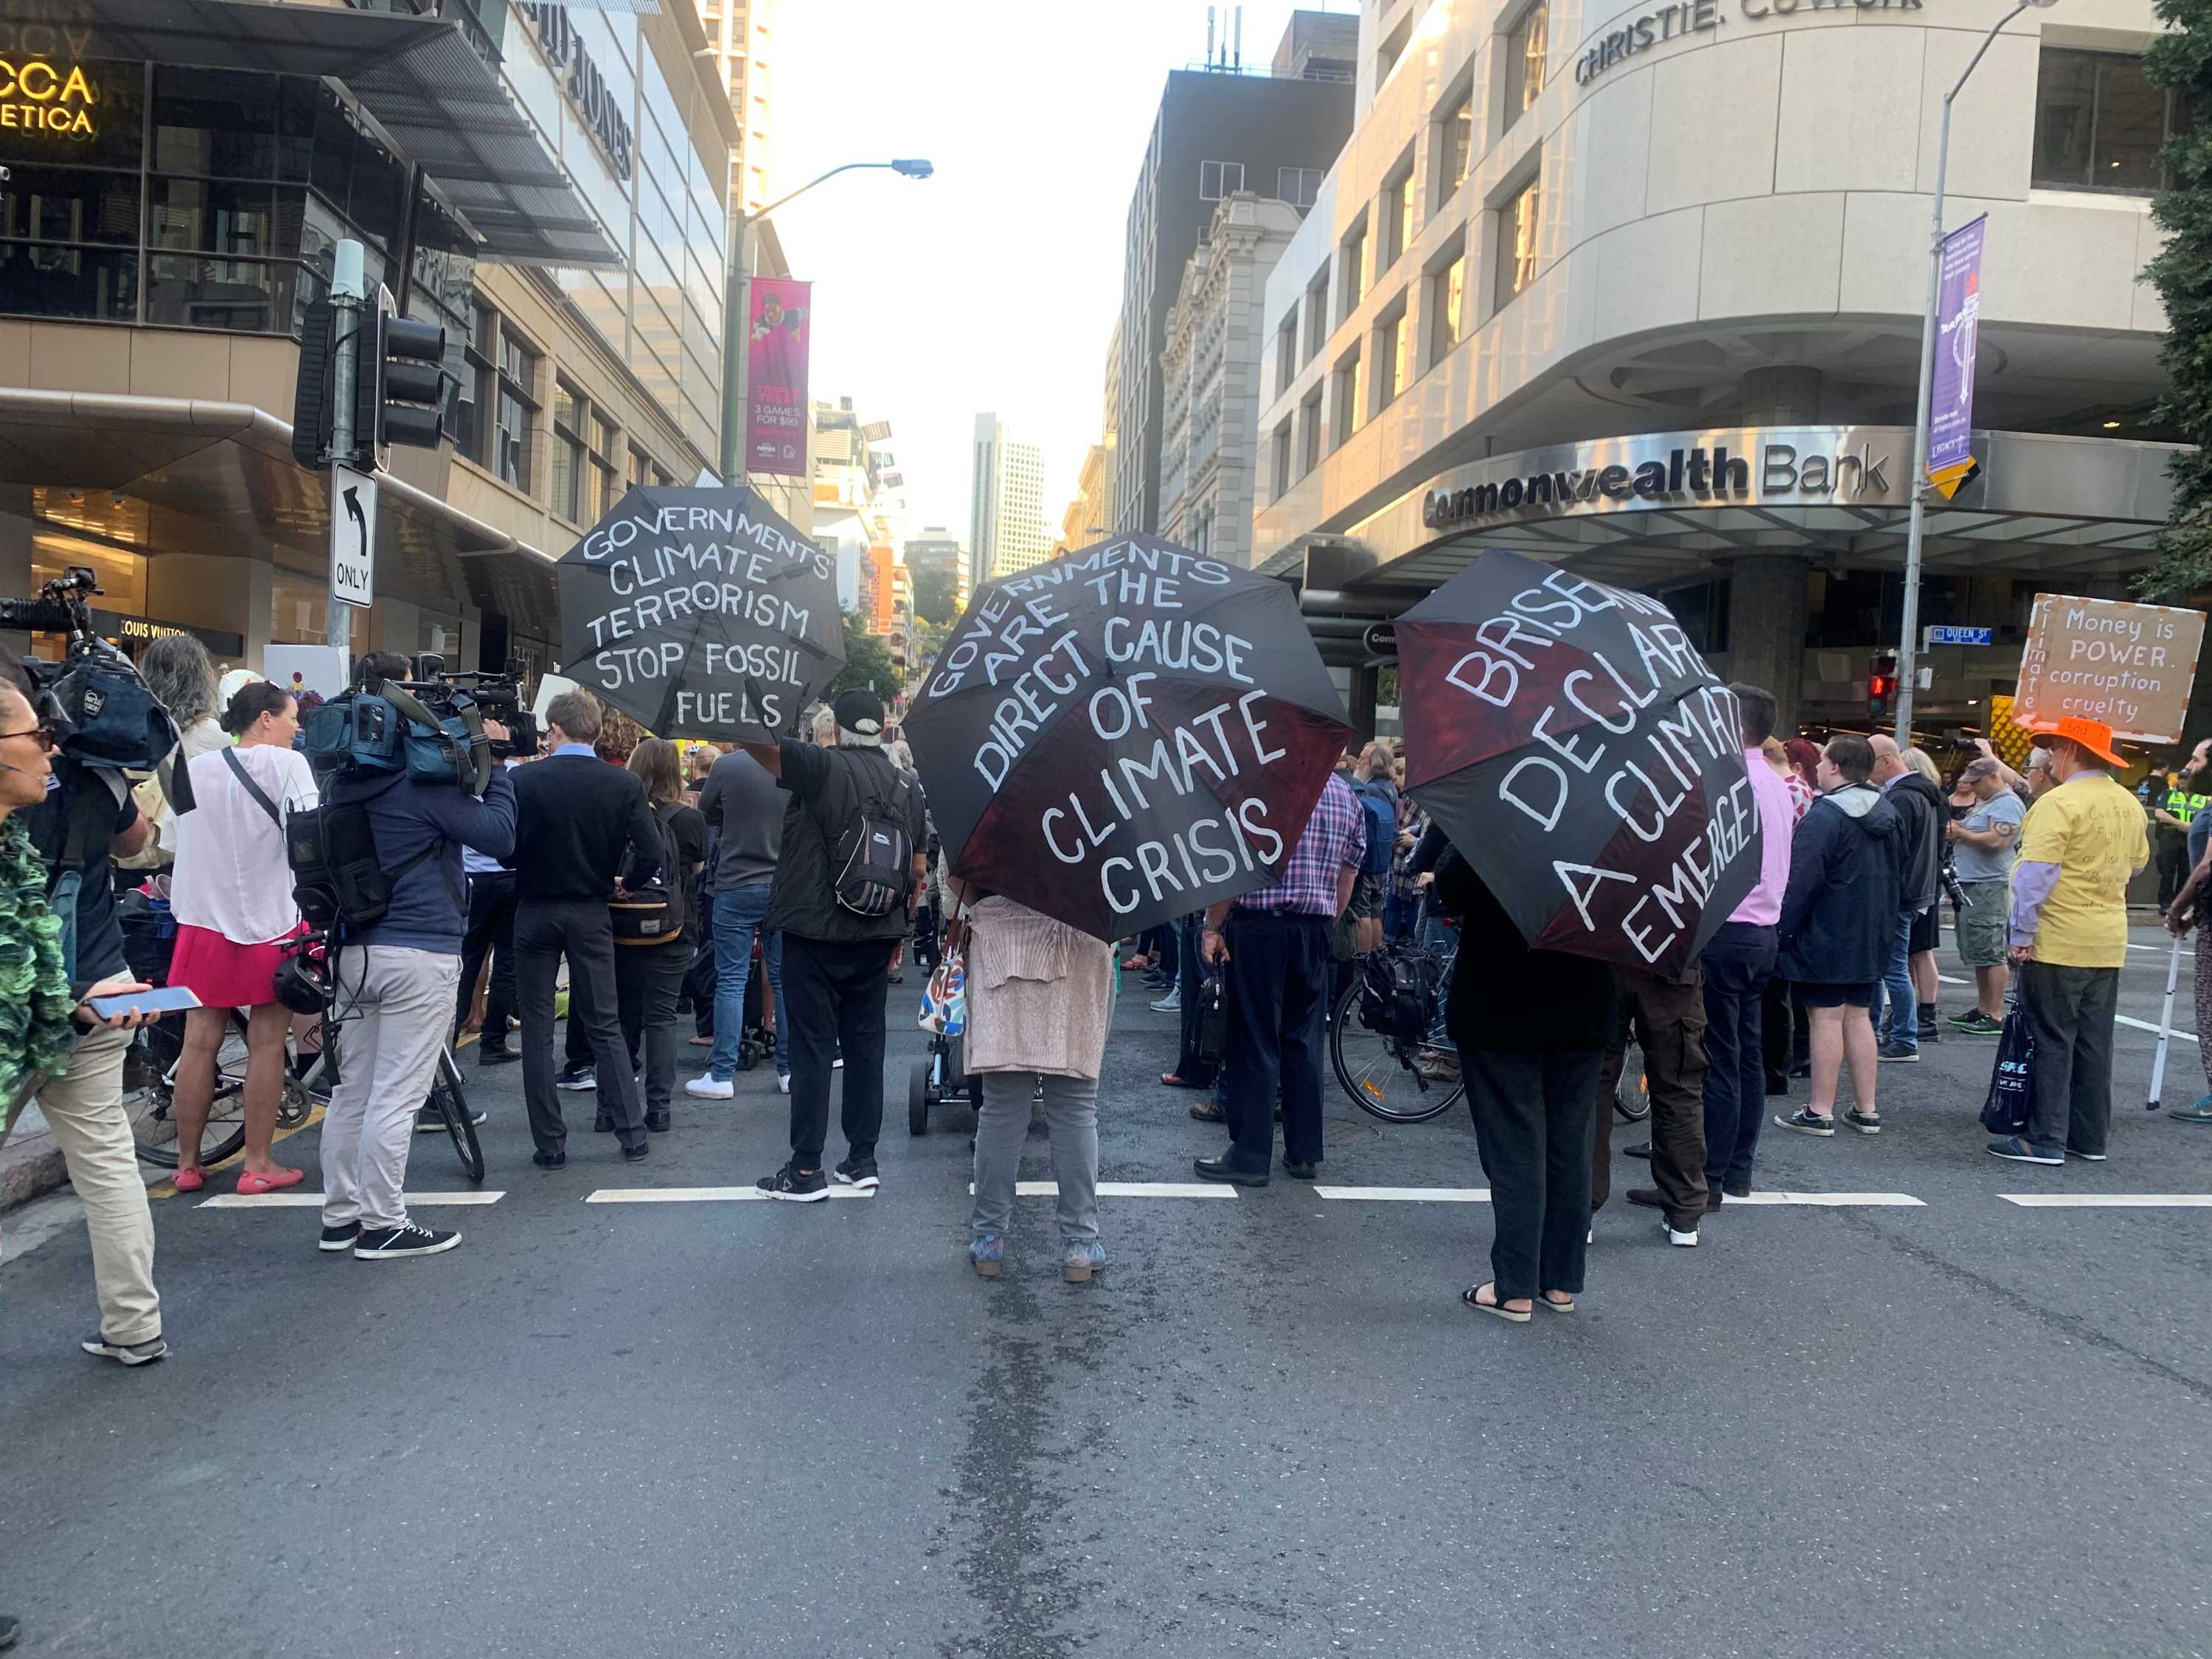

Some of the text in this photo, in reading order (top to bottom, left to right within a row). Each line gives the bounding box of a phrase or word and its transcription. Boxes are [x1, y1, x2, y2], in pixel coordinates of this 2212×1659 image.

[1, 104, 94, 133] ETICA
[755, 405, 800, 417] 3 GAMES
[756, 414, 777, 425] FOR
[337, 563, 368, 591] ONLY
[610, 542, 773, 596] CLIMATE
[121, 619, 148, 638] LOUIS
[586, 580, 810, 648] TERRORISM
[928, 540, 1231, 699] GOVERNMENTS
[984, 568, 1183, 686] ARE THE
[1947, 628, 1987, 639] QUEEN ST
[2066, 608, 2174, 641] Money is
[595, 641, 803, 690] STOP FOSSIL
[2025, 599, 2053, 709] climate
[2049, 669, 2161, 693] corruption
[676, 691, 782, 728] FUELS
[973, 616, 1254, 793] DIRECT CAUSE
[1088, 672, 1159, 740] OF
[2062, 696, 2138, 723] cruelty
[1040, 689, 1287, 864] CLIMATE
[1099, 797, 1284, 914] CRISIS
[2083, 855, 2096, 863] or
[1553, 859, 1637, 931] A
